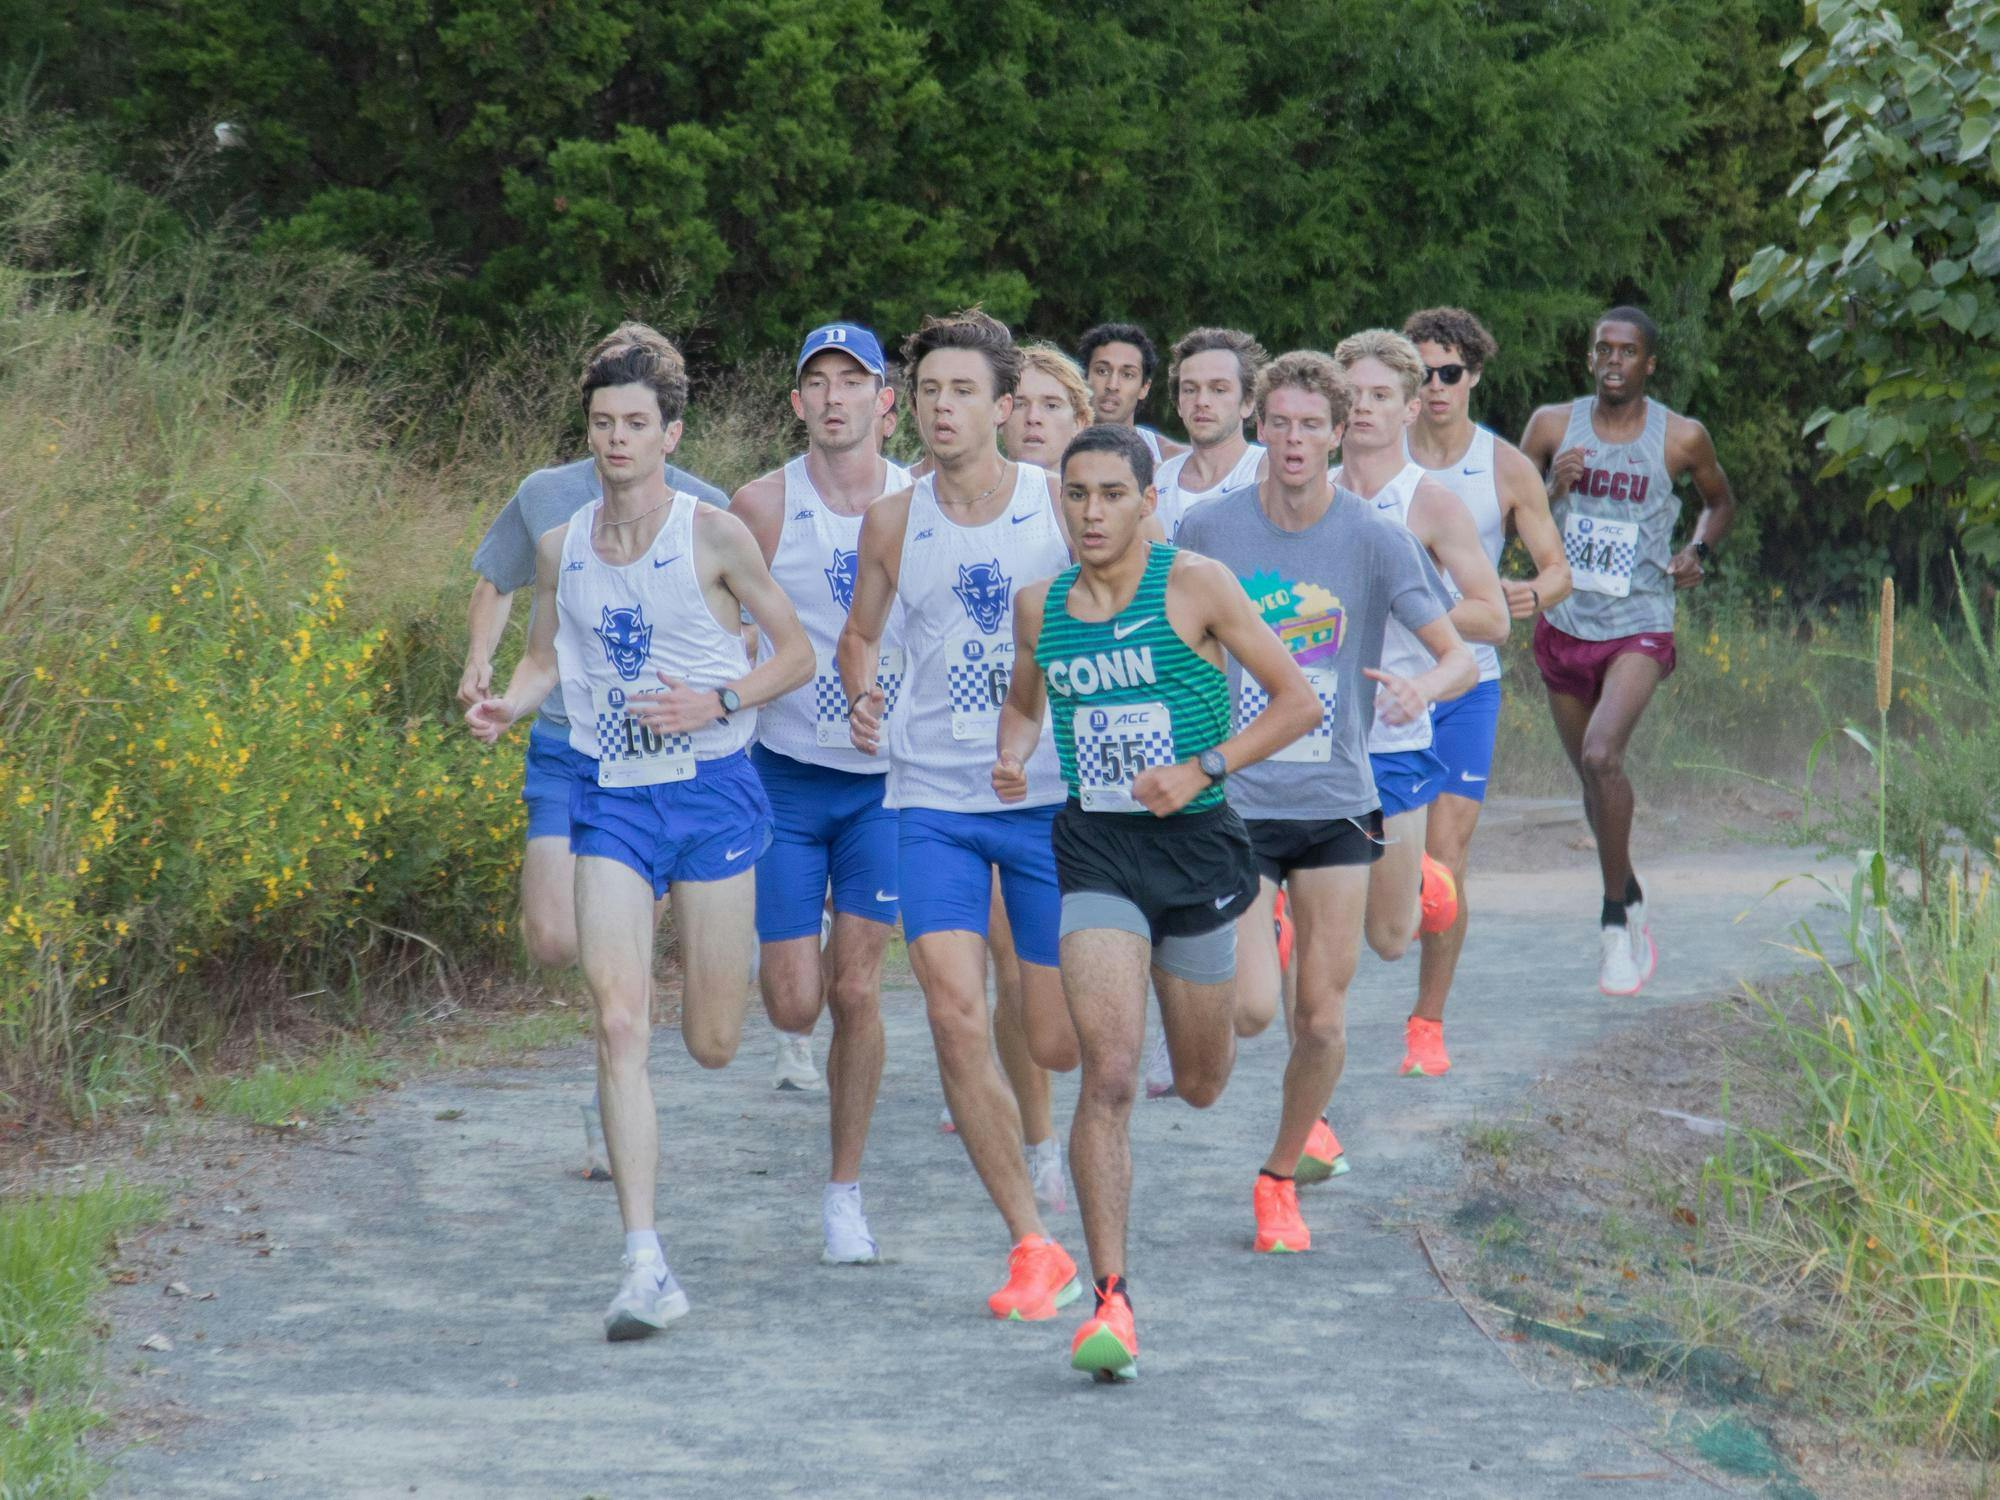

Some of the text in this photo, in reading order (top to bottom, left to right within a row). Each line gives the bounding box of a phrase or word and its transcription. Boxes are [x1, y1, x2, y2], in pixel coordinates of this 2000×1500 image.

[823, 329, 847, 344] D
[1580, 543, 1613, 573] 44
[1047, 646, 1156, 698] CONN
[1114, 712, 1151, 726] ACC
[1100, 741, 1146, 783] 55
